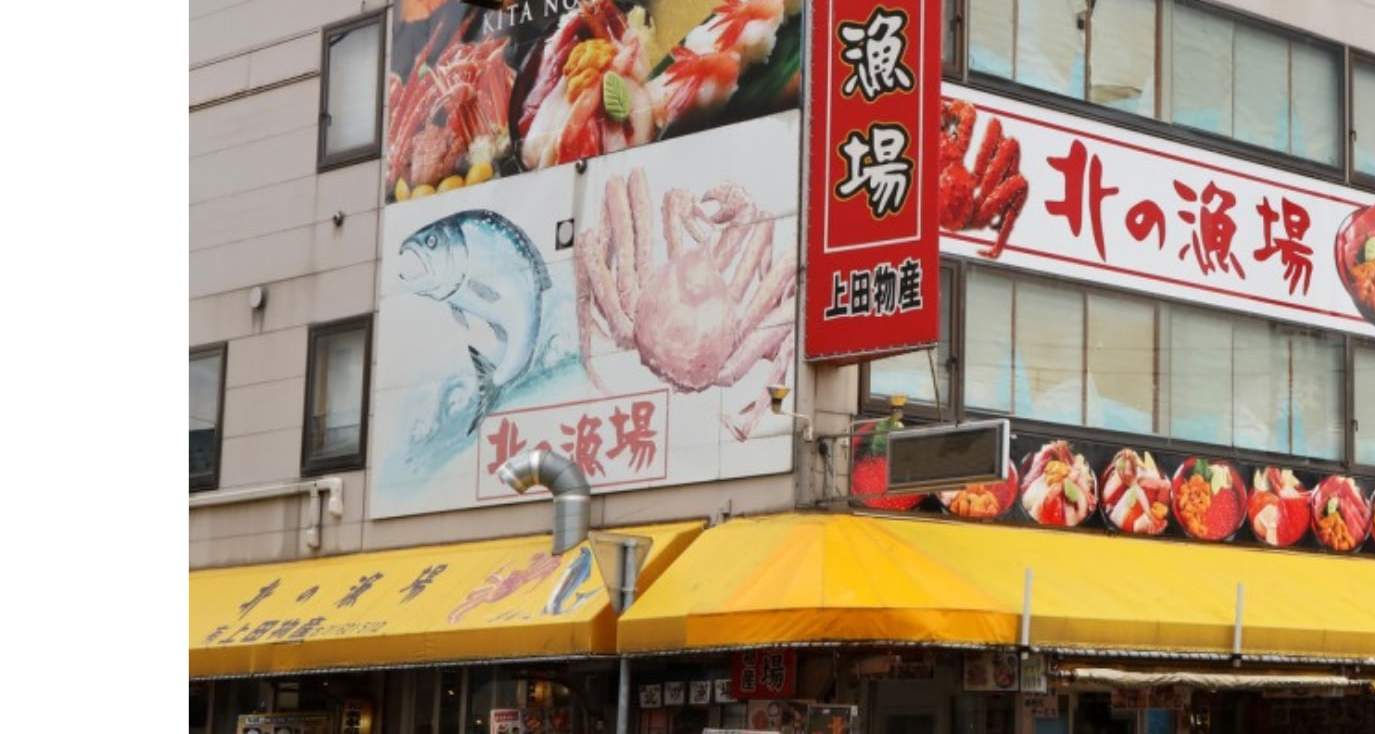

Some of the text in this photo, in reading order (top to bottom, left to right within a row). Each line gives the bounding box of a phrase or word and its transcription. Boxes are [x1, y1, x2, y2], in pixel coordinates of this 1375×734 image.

[483, 1, 534, 35] KITA
[1044, 139, 1314, 296] 北の漁場
[824, 258, 922, 320] 上田物産
[487, 401, 657, 478] 北漁場
